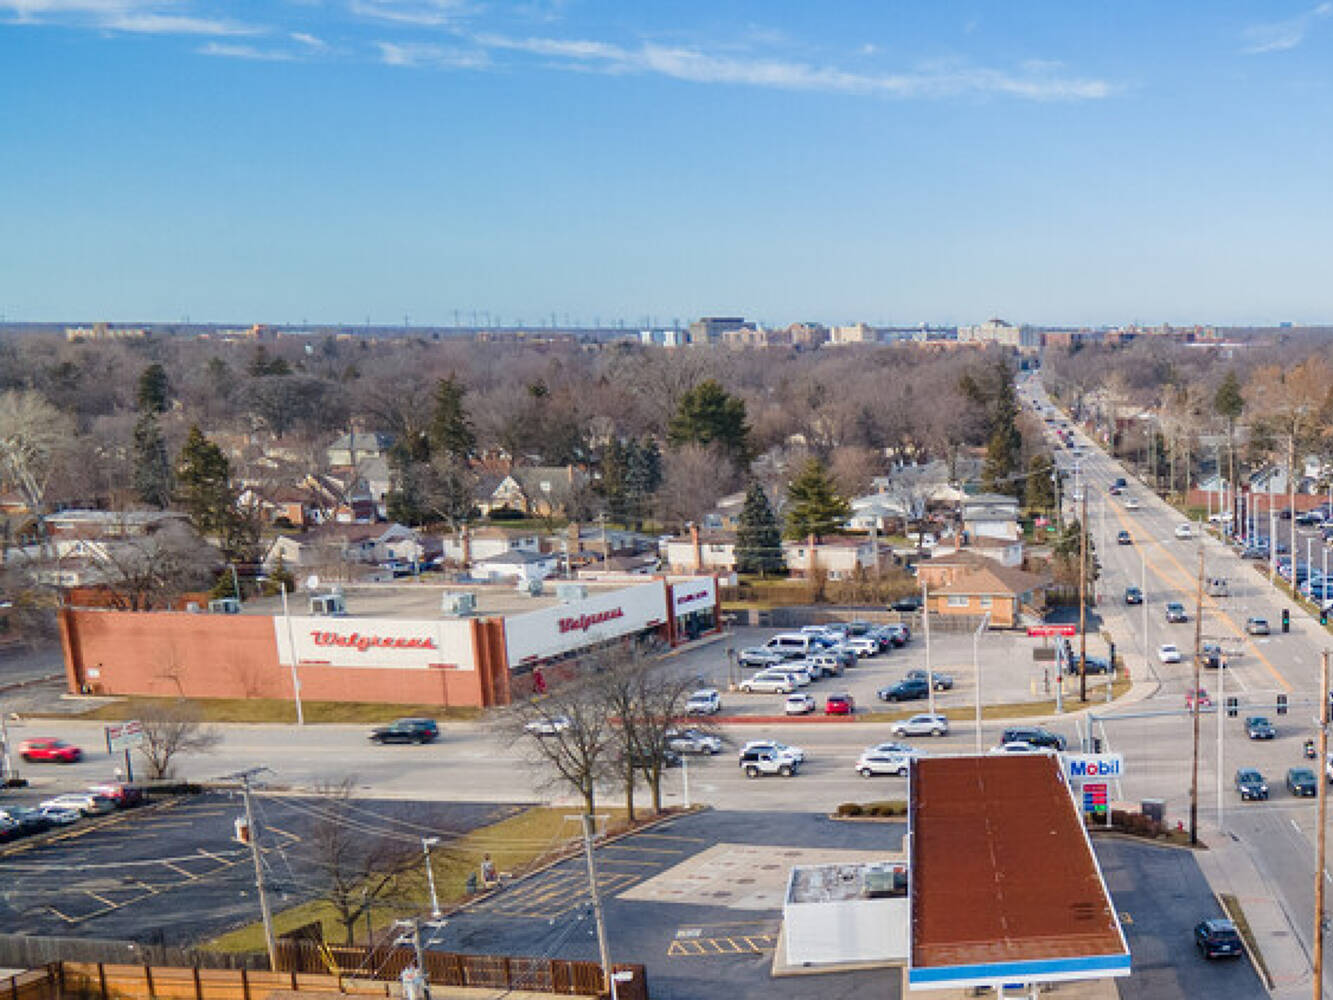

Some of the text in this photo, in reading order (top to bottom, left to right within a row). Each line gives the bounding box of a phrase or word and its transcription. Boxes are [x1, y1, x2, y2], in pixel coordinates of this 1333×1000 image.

[558, 607, 624, 633] Walgreens
[310, 632, 439, 652] Walgreens
[1071, 760, 1119, 775] Mobil
